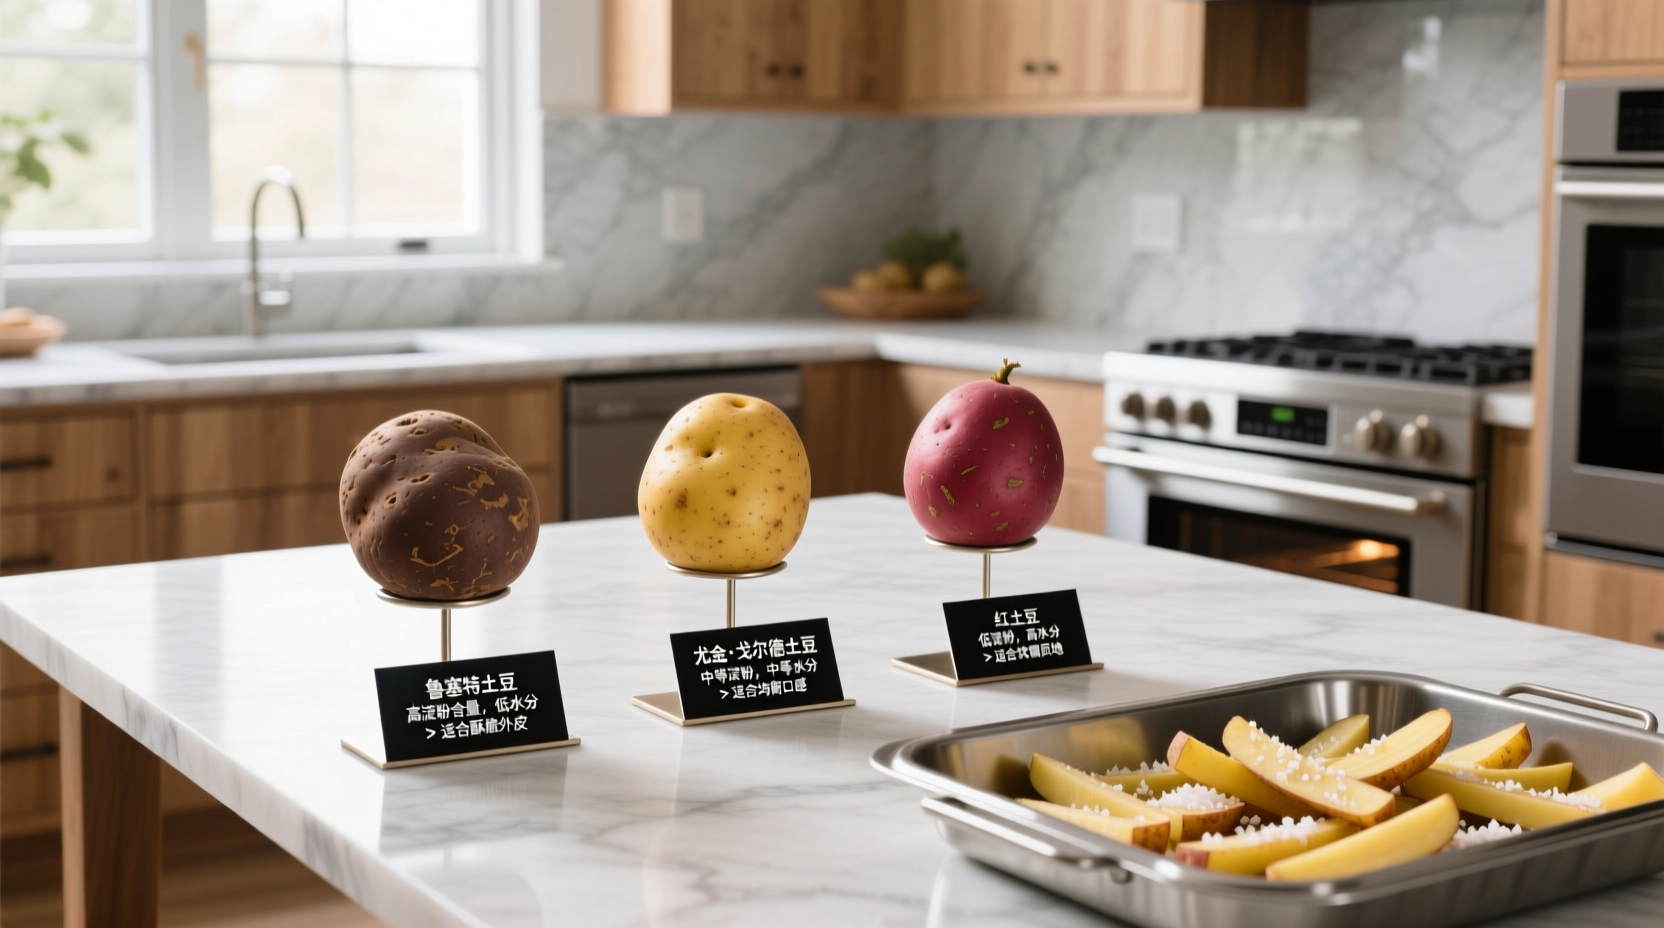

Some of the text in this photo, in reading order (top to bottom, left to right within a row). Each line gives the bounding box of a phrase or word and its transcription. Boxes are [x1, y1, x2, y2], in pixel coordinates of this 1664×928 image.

[994, 608, 1040, 628] 红土豆
[426, 672, 518, 700] 鲁塞特土豆
